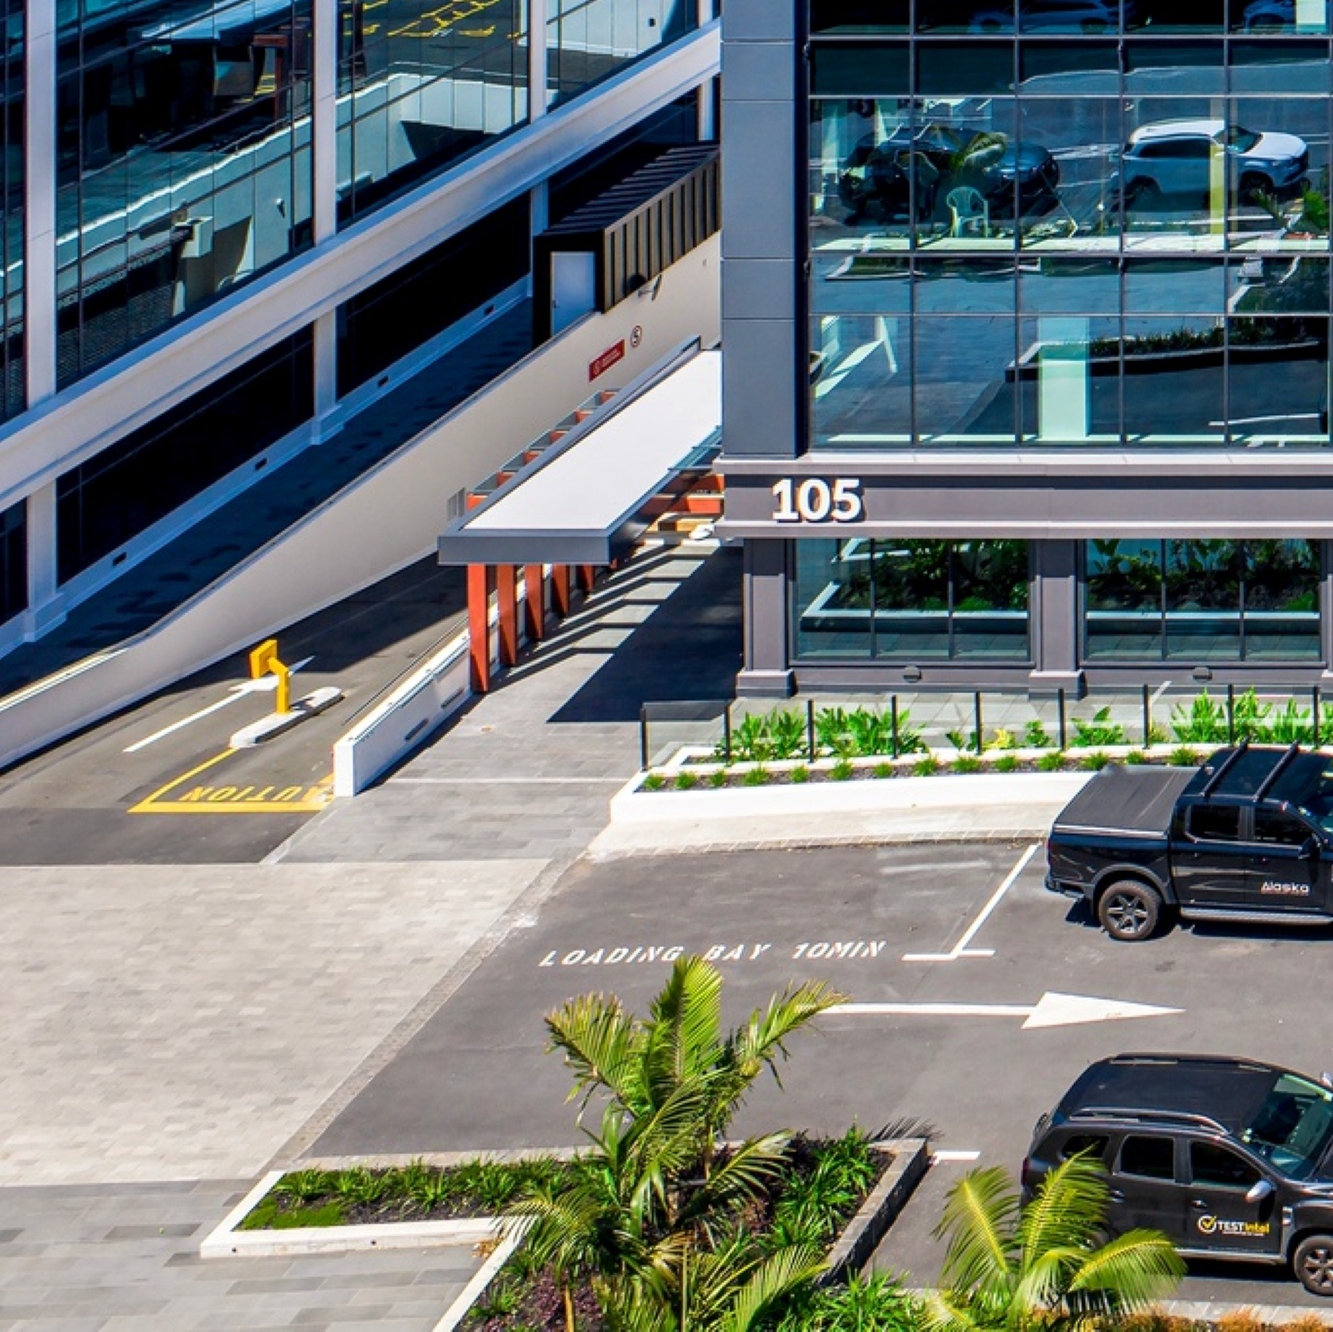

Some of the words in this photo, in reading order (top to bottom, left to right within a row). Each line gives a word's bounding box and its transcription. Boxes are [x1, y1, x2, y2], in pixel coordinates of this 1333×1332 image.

[772, 478, 862, 521] 105
[538, 946, 684, 966] LOADING
[701, 944, 771, 961] BAY
[792, 941, 886, 959] 10MIN
